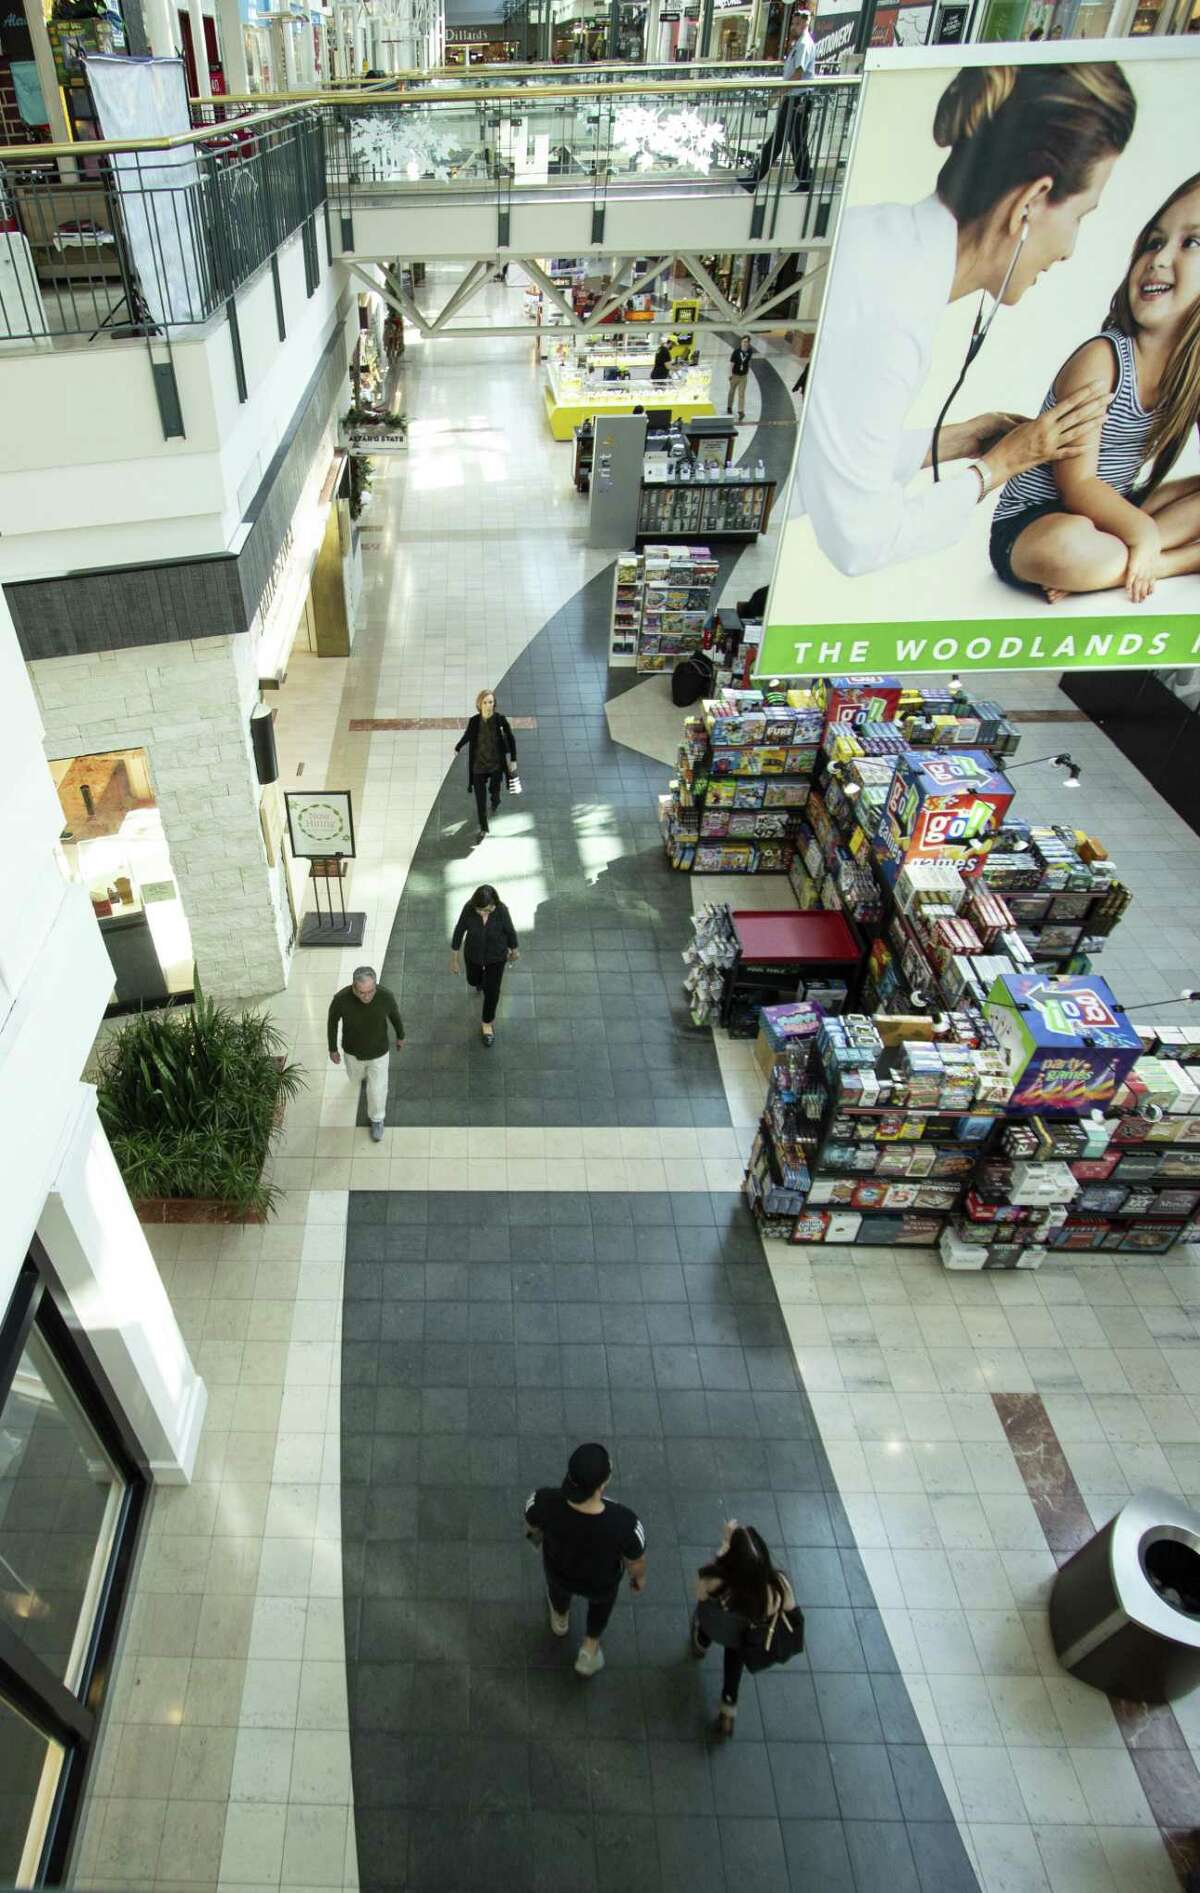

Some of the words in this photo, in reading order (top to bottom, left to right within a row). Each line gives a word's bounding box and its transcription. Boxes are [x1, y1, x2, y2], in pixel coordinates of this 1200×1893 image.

[445, 28, 488, 41] Dillard's
[794, 640, 870, 664] THE
[896, 632, 1171, 661] WOODLANDS
[1041, 1058, 1085, 1072] party
[1047, 1071, 1094, 1081] games
